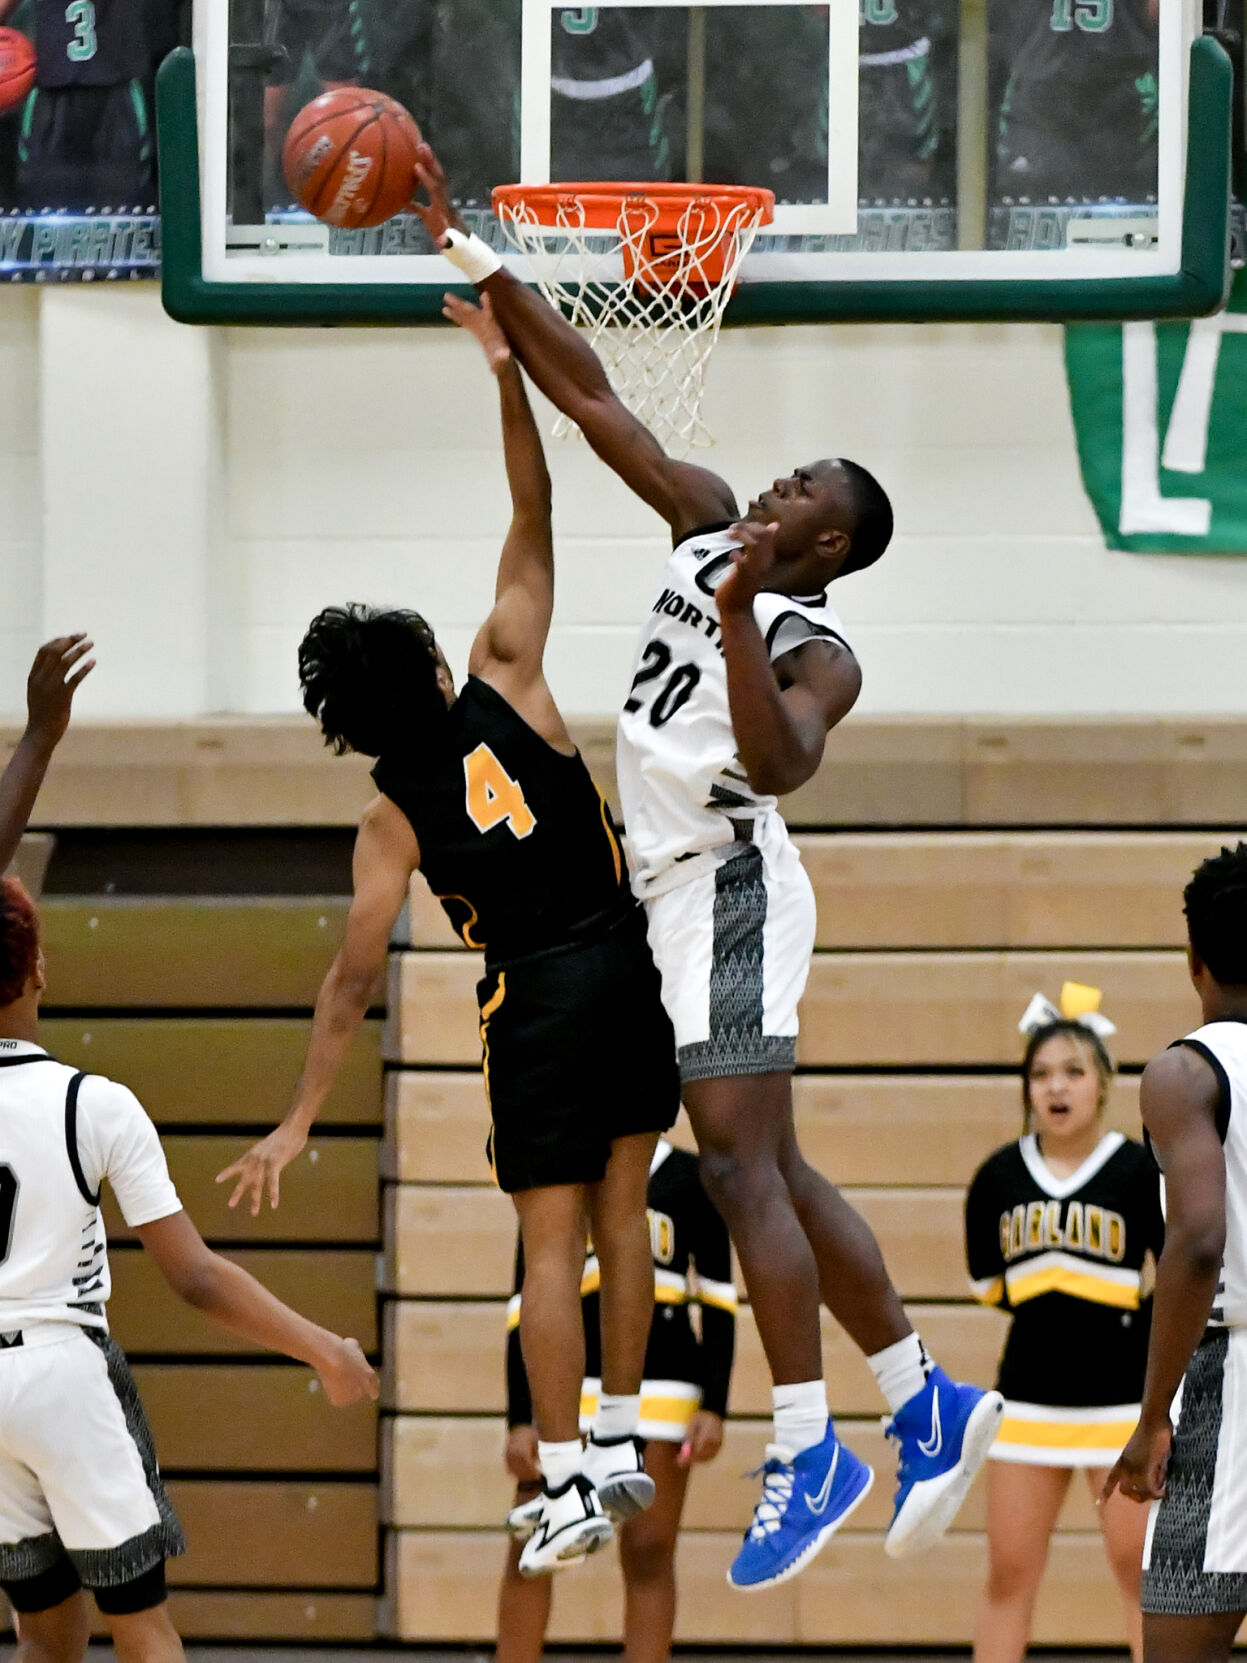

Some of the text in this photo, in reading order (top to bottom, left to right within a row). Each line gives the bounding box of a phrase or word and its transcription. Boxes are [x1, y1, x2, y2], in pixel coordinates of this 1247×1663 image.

[65, 0, 97, 61] 3
[30, 218, 162, 265] PIRATE
[652, 588, 726, 658] NORT
[623, 637, 703, 729] 20
[463, 742, 537, 840] 4
